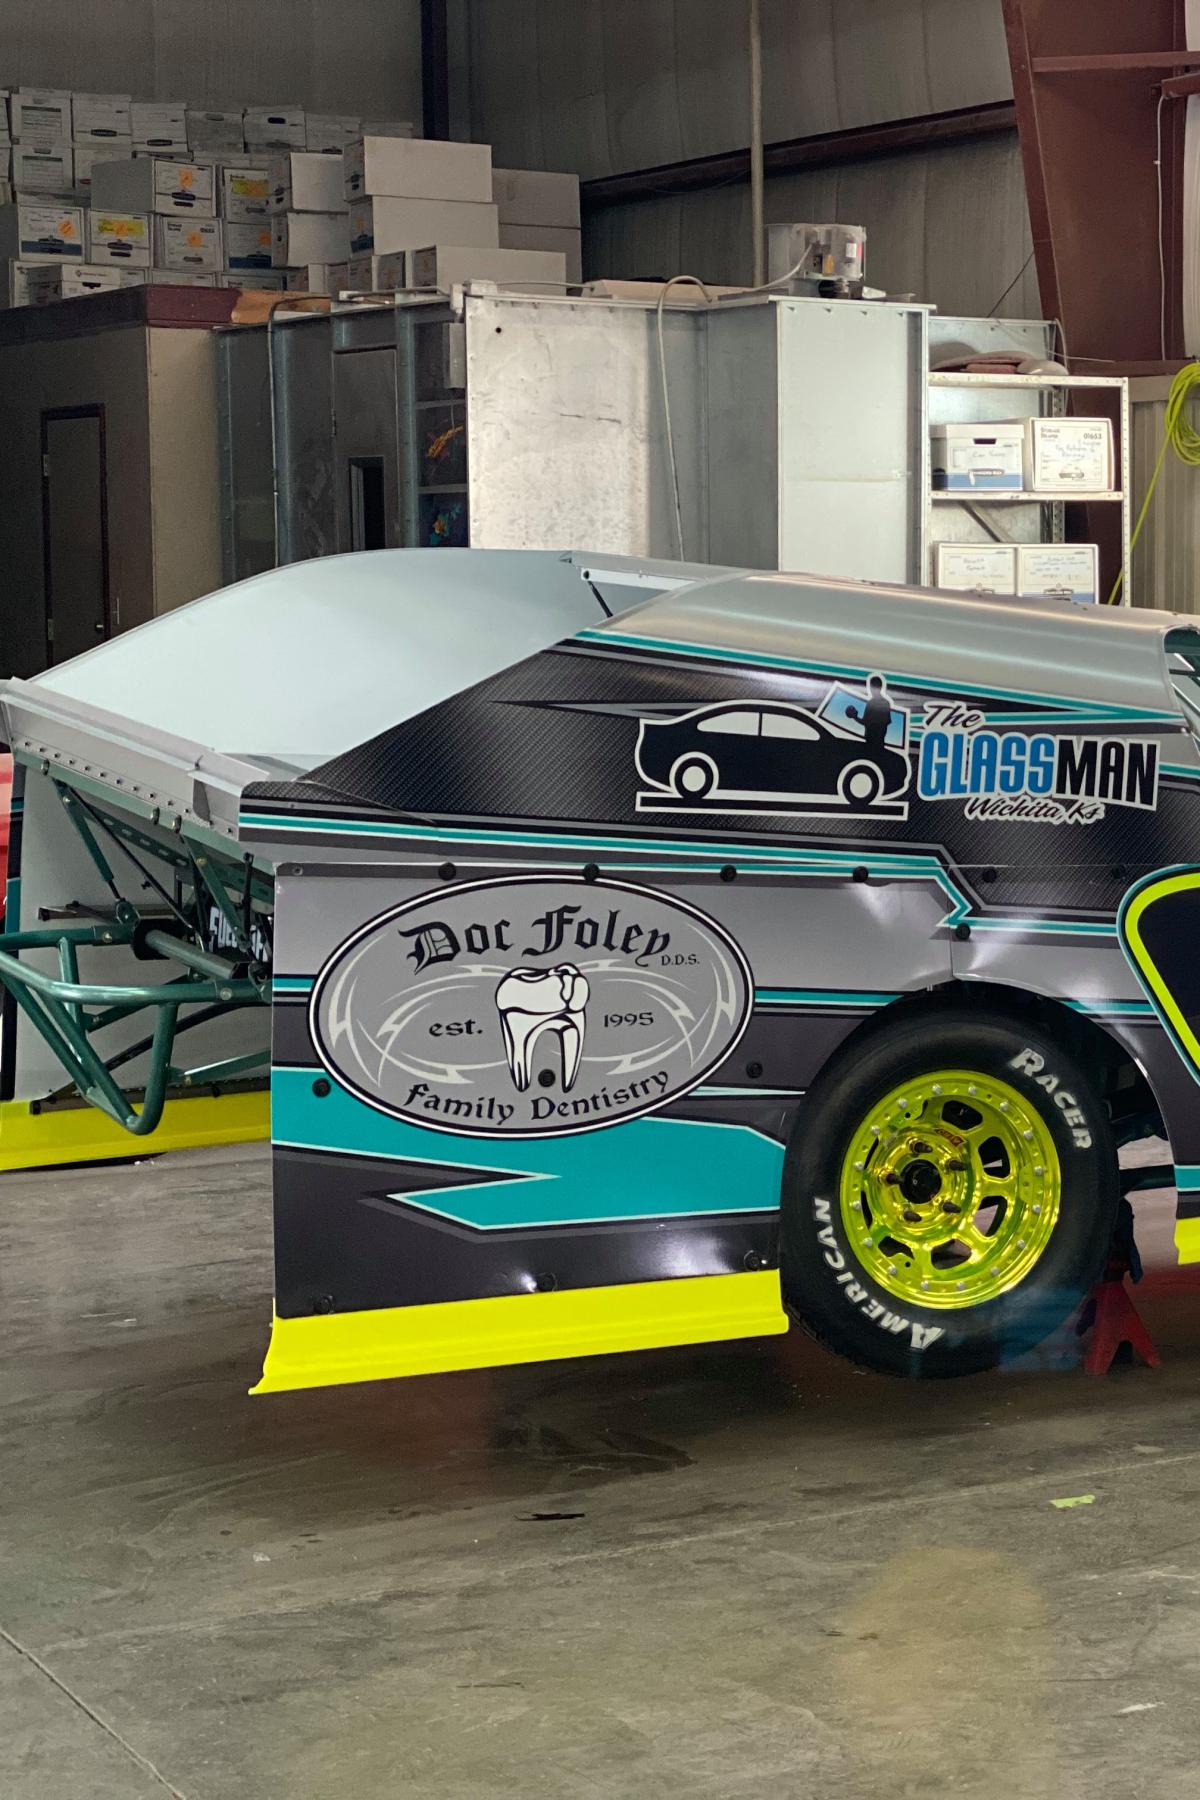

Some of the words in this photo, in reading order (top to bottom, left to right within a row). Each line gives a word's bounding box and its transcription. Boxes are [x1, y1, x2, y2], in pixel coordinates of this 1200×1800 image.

[922, 703, 982, 730] The
[398, 918, 514, 975] Doc
[521, 904, 671, 968] Foley
[660, 953, 700, 966] D.D.S.
[428, 1017, 484, 1038] est.
[603, 1011, 655, 1028] 1995
[402, 1082, 515, 1125] Family
[530, 1070, 671, 1121] Dentistry
[1009, 1047, 1094, 1150] RACER
[813, 1198, 946, 1351] AMERICAN
